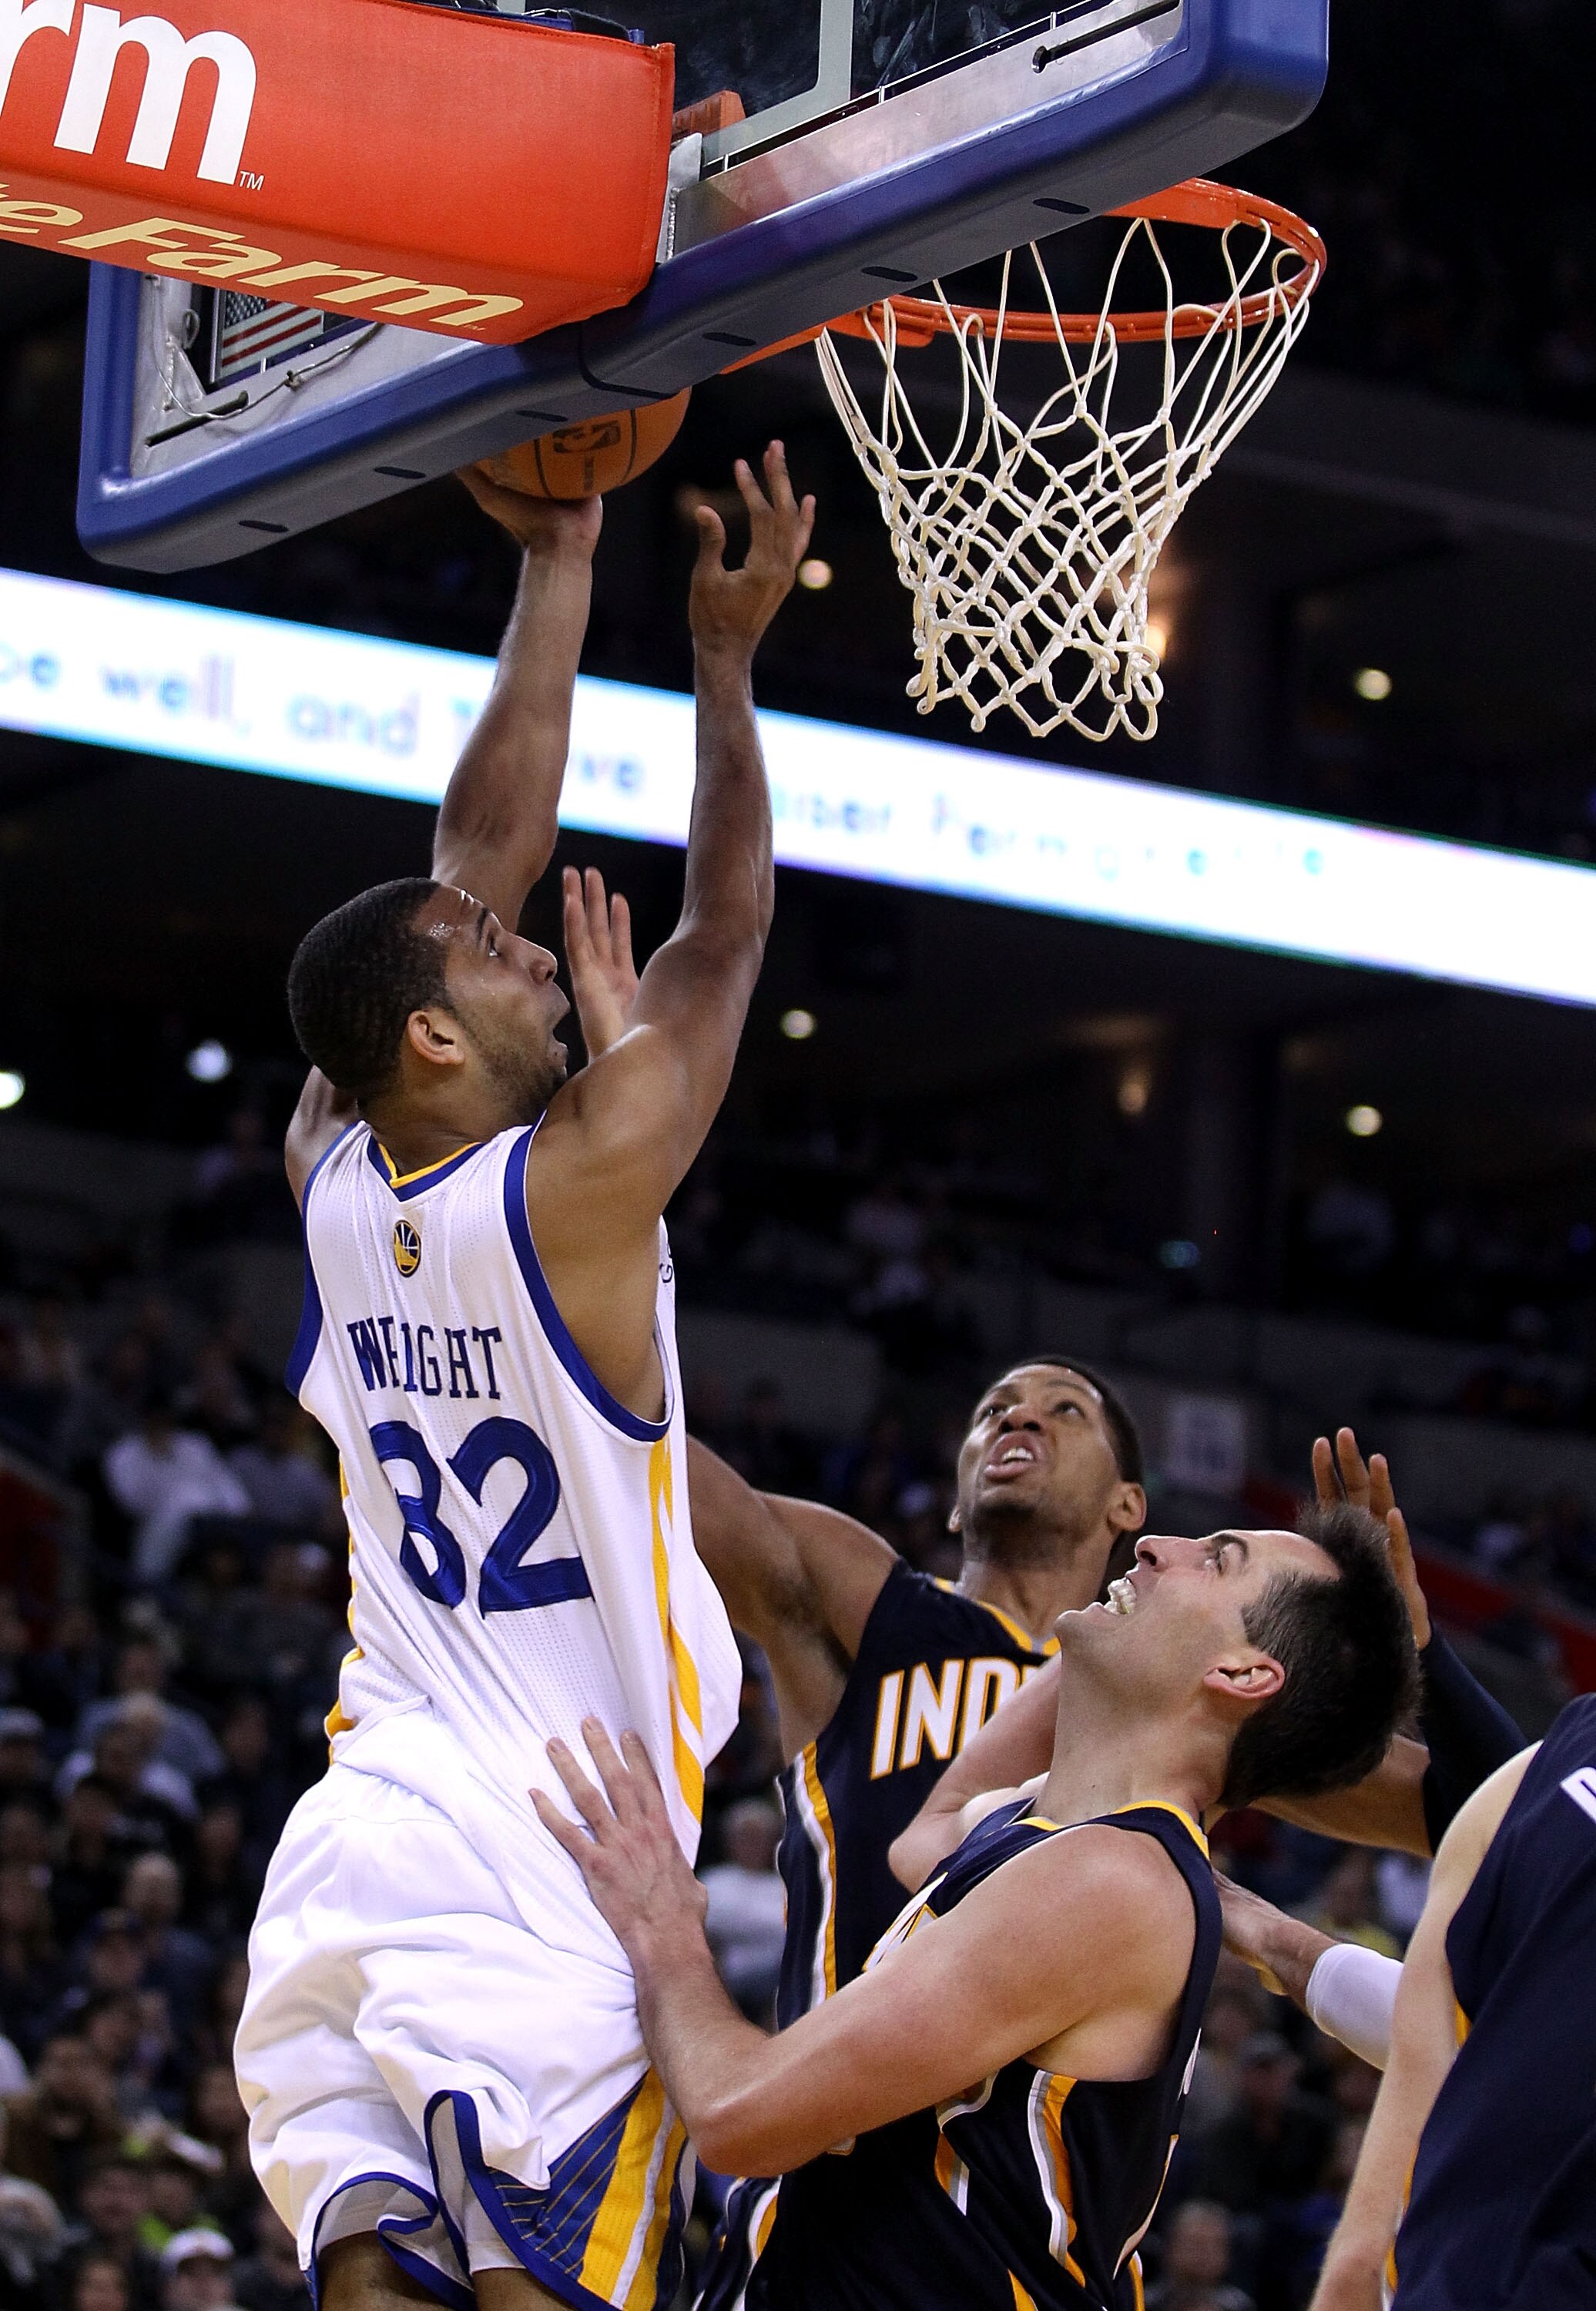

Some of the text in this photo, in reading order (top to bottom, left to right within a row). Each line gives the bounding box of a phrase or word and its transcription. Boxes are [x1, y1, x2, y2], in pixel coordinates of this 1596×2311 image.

[0, 182, 525, 327] e Farm
[283, 689, 422, 761] and
[870, 1656, 1038, 1781] IND
